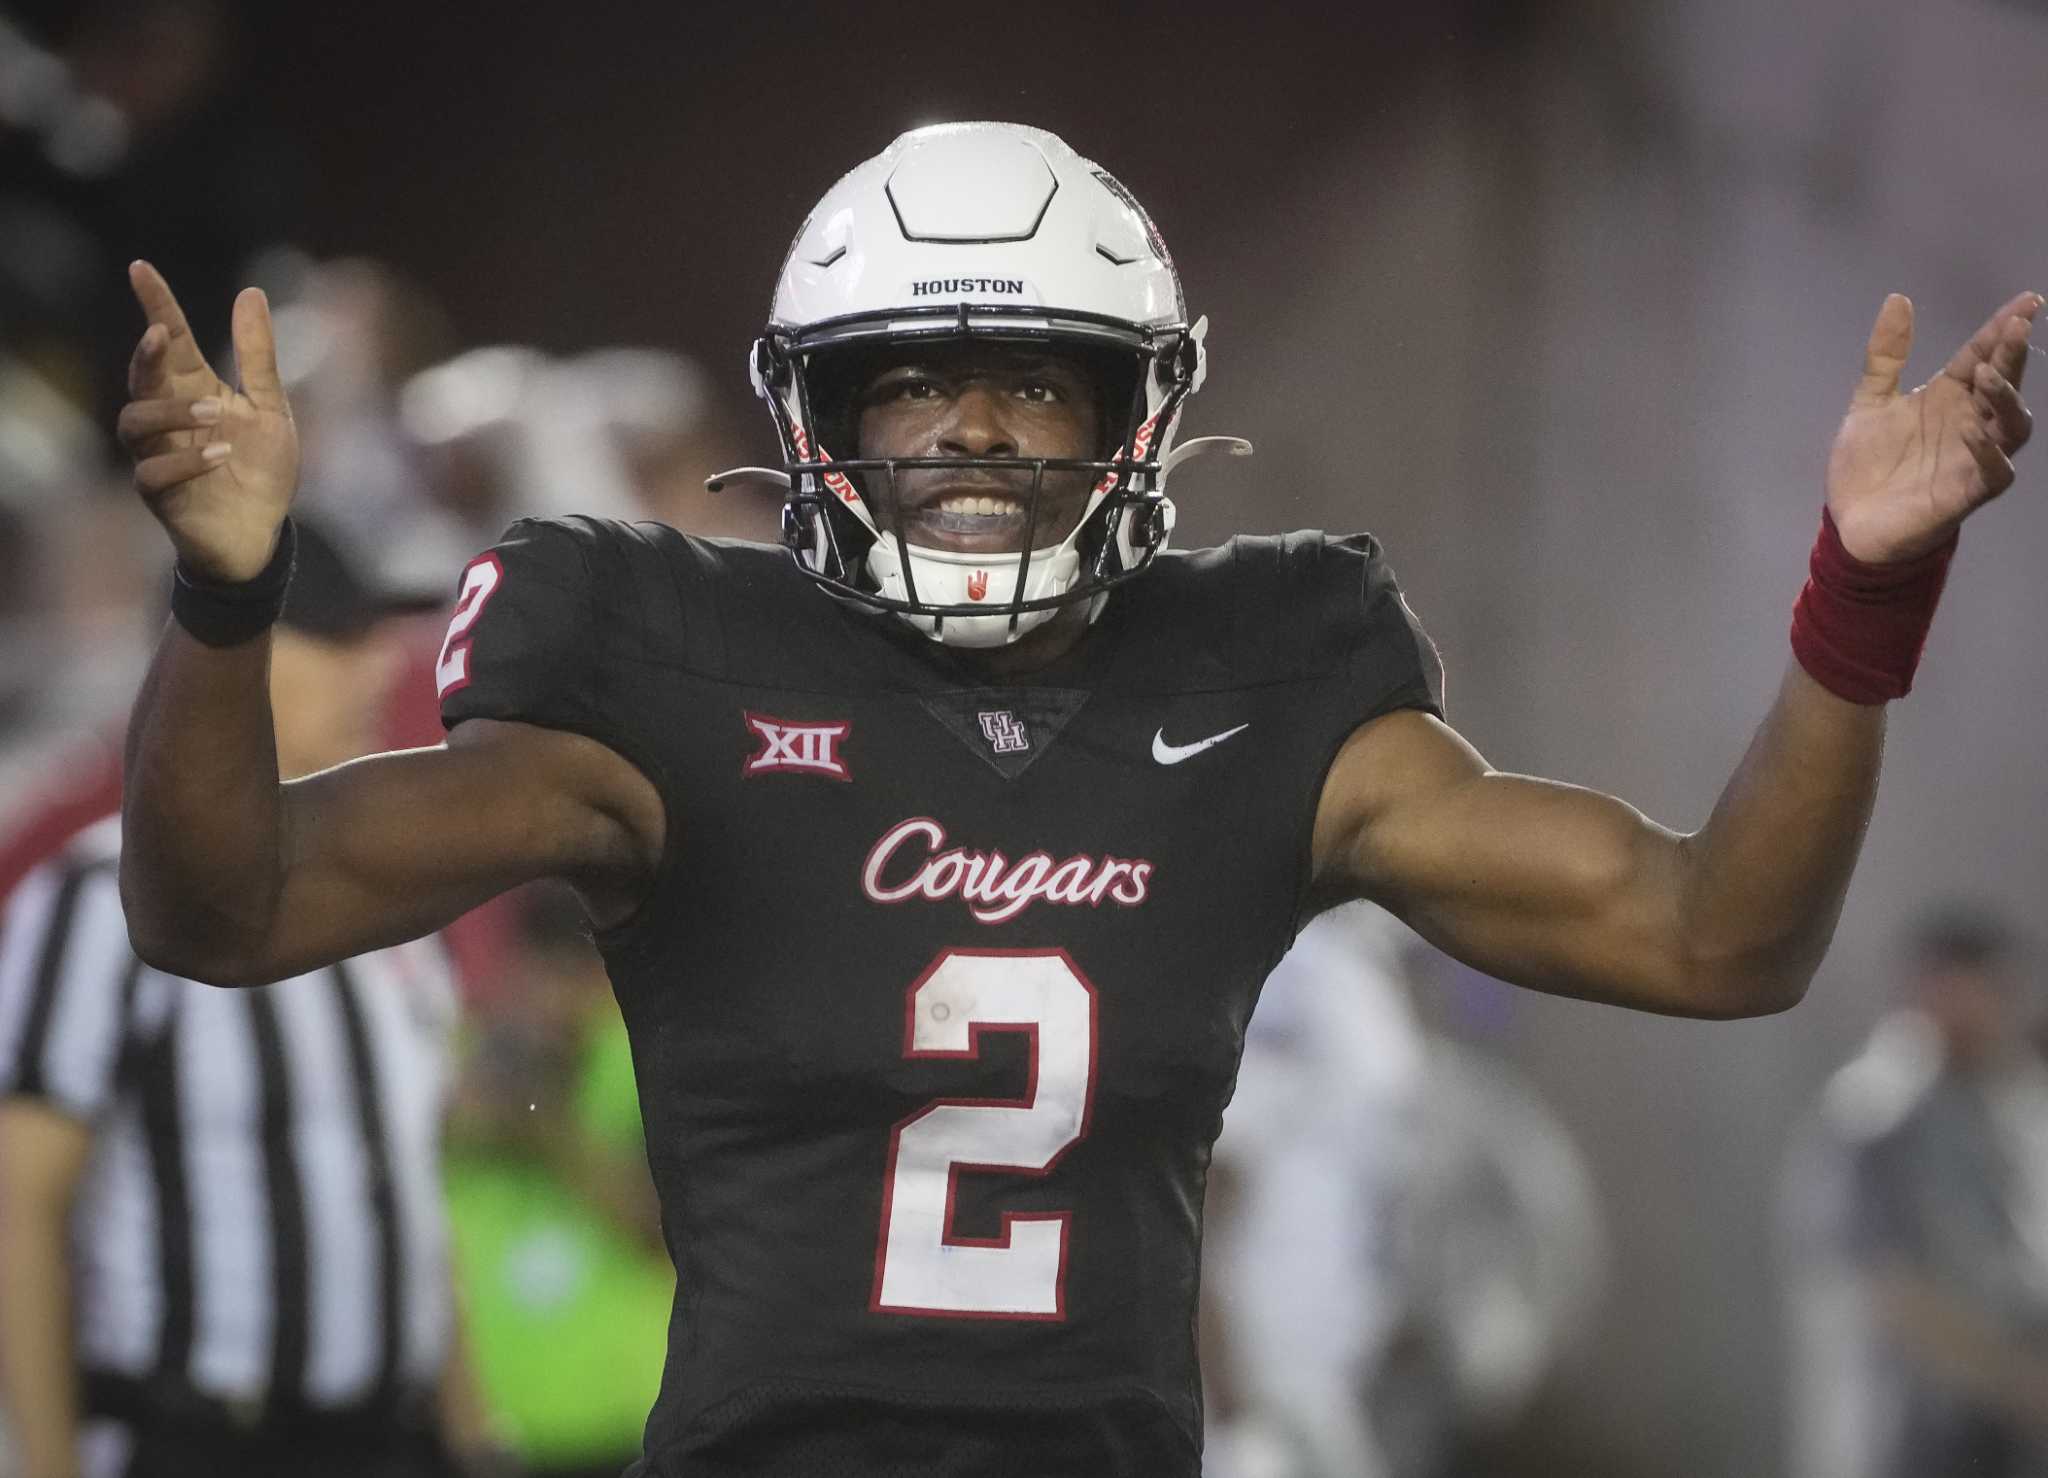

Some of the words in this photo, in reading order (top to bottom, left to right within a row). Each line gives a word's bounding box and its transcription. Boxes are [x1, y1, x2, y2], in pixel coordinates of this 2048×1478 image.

[912, 278, 1024, 297] HOUSTON
[436, 549, 504, 700] 2
[749, 717, 847, 775] XII
[861, 816, 1154, 924] Cougars
[869, 946, 1099, 1321] 2
